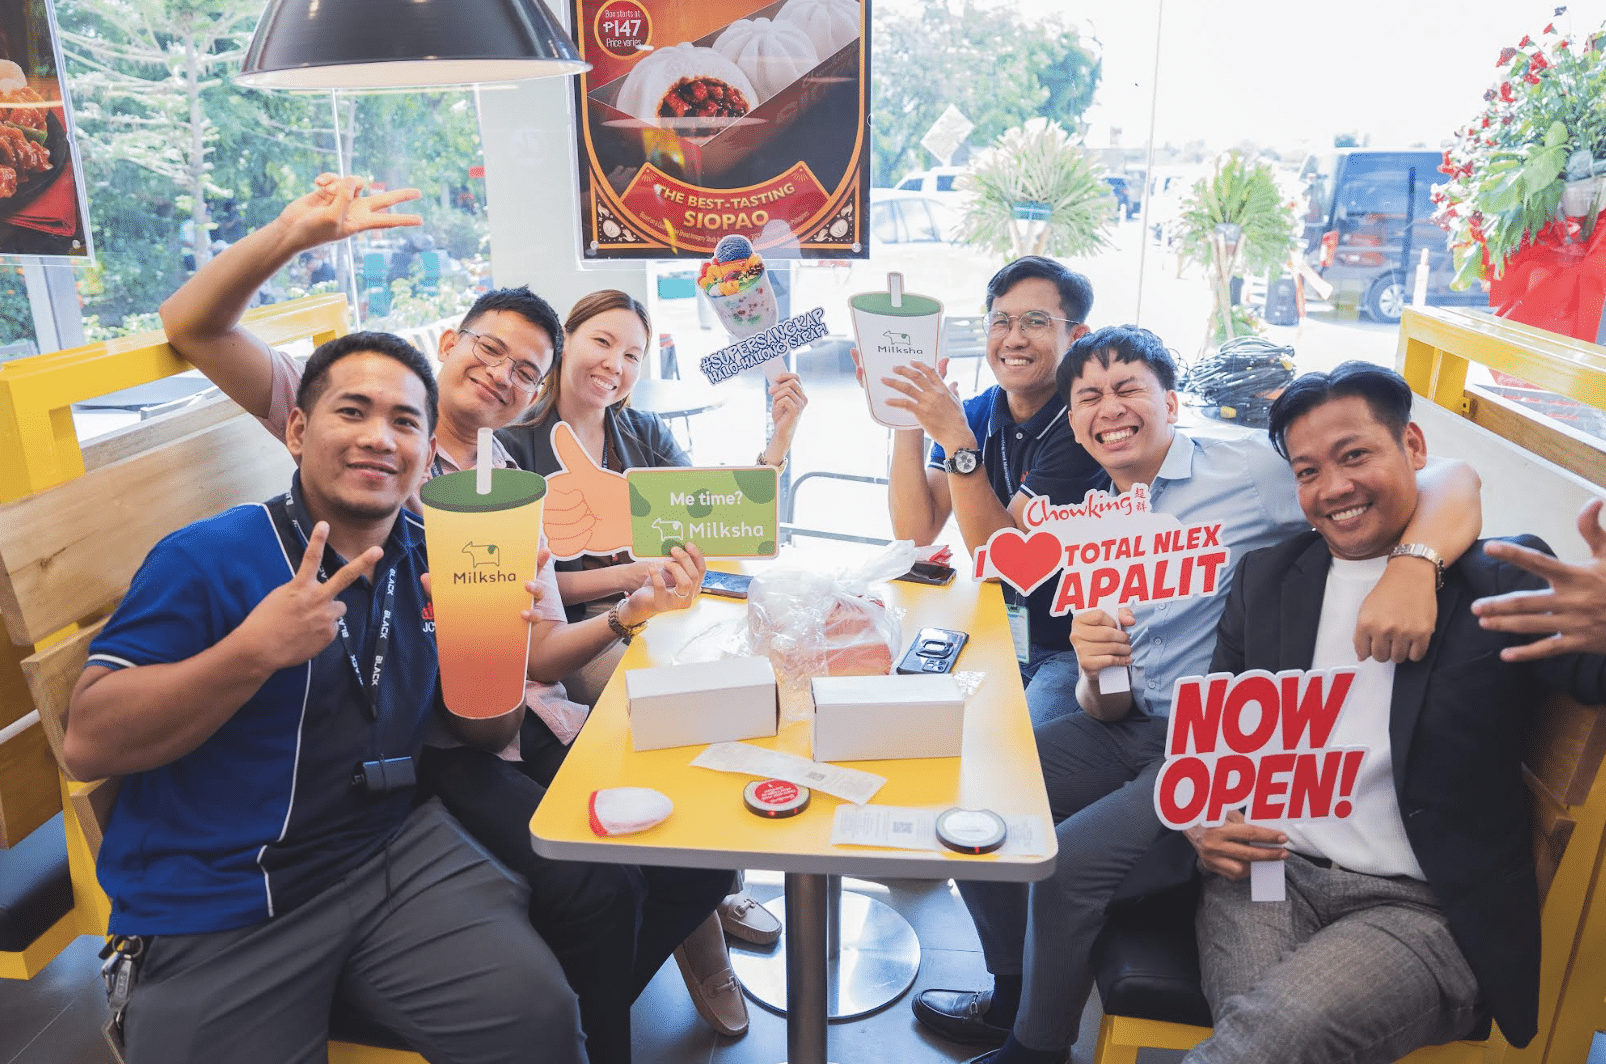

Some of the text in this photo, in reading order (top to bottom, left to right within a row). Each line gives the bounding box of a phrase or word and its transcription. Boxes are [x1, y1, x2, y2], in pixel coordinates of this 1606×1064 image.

[606, 38, 622, 47] Price
[656, 182, 796, 210] THE BEST-TASTING
[683, 210, 770, 231] SIOPAO
[701, 308, 824, 374] #SUPERSANGKAP
[708, 323, 828, 384] HALO-HALONG SARAP!
[877, 345, 924, 355] Milksha
[670, 490, 743, 506] Me time?
[1027, 494, 1133, 527] Chowking
[689, 521, 764, 539] Milksha
[1065, 523, 1222, 567] TOTAL NLEX
[453, 570, 517, 585] Milksha
[975, 550, 987, 578] I
[387, 567, 397, 596] BLACK
[1055, 551, 1227, 613] APALIT
[379, 609, 391, 640] BLACK
[371, 655, 384, 686] BLACK
[1171, 672, 1356, 755] NOW
[1159, 750, 1365, 825] OPEN!
